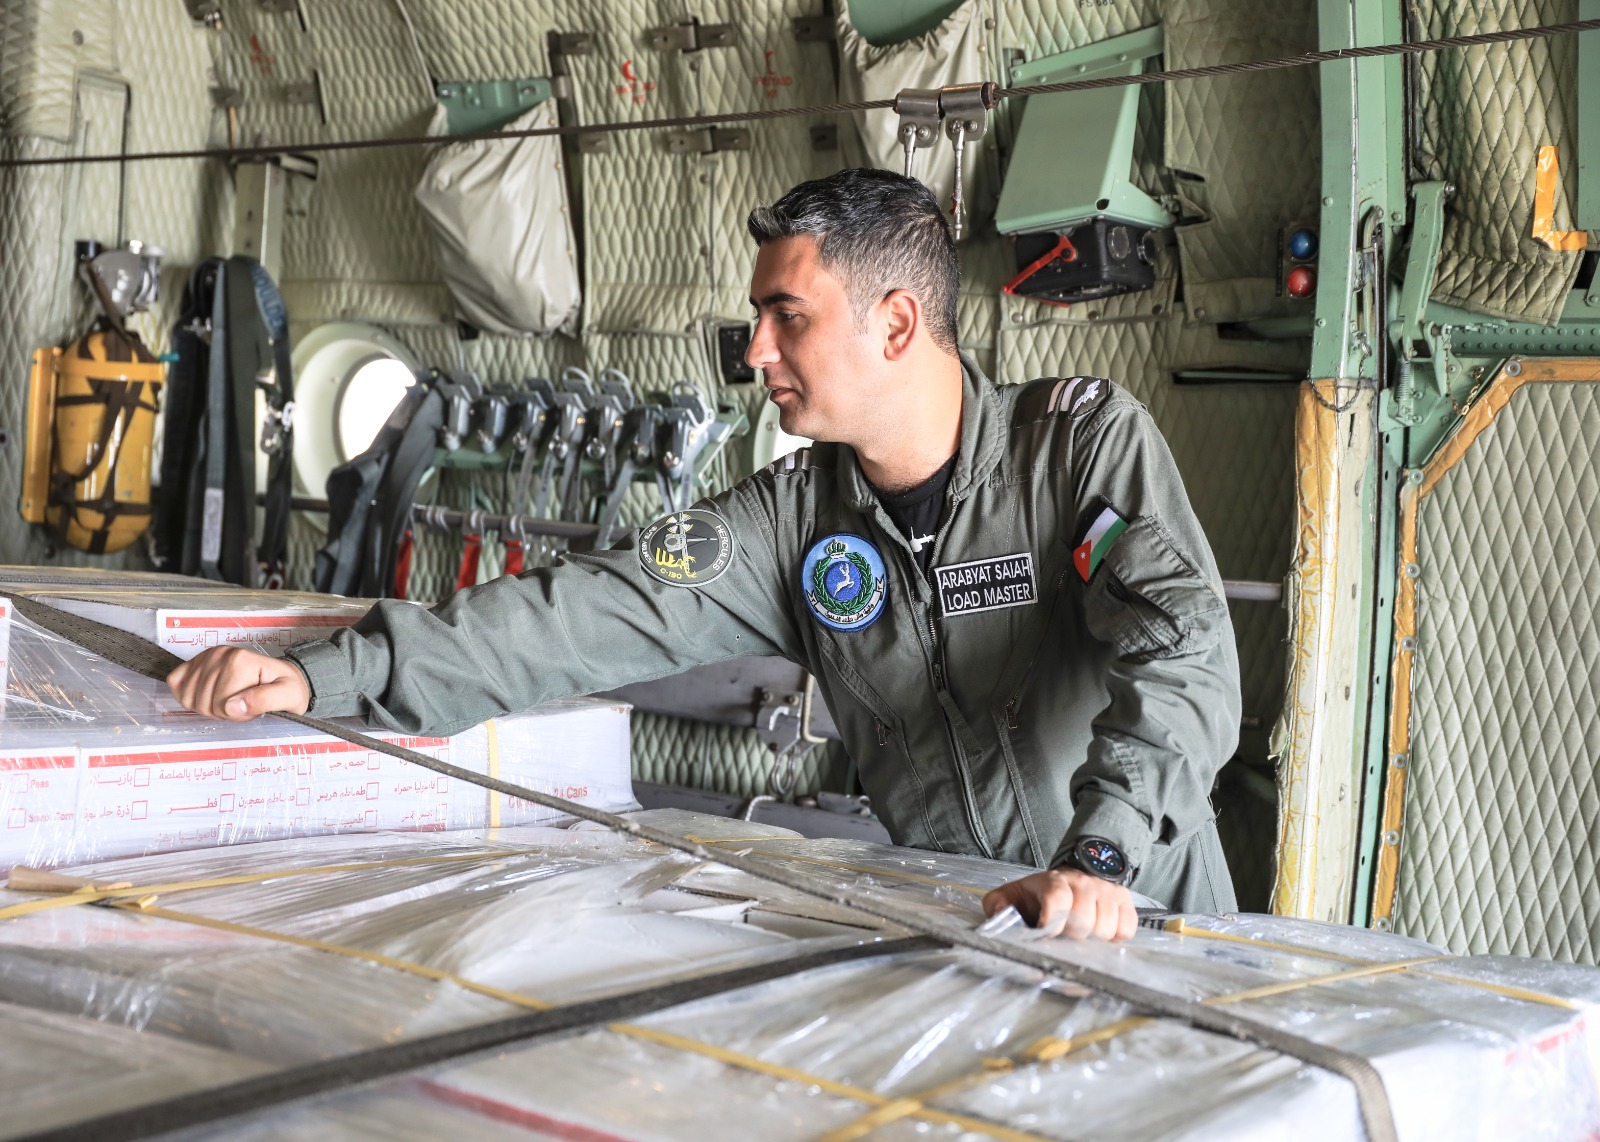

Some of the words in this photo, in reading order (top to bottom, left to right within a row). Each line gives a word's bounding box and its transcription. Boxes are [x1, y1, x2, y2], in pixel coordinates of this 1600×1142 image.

[712, 524, 729, 571] HERCULES
[660, 568, 682, 579] C-130
[942, 566, 991, 589] ARABYAT
[946, 590, 981, 610] LOAD
[984, 583, 1031, 606] MASTER
[30, 779, 49, 788] Peas
[566, 785, 588, 799] Cans
